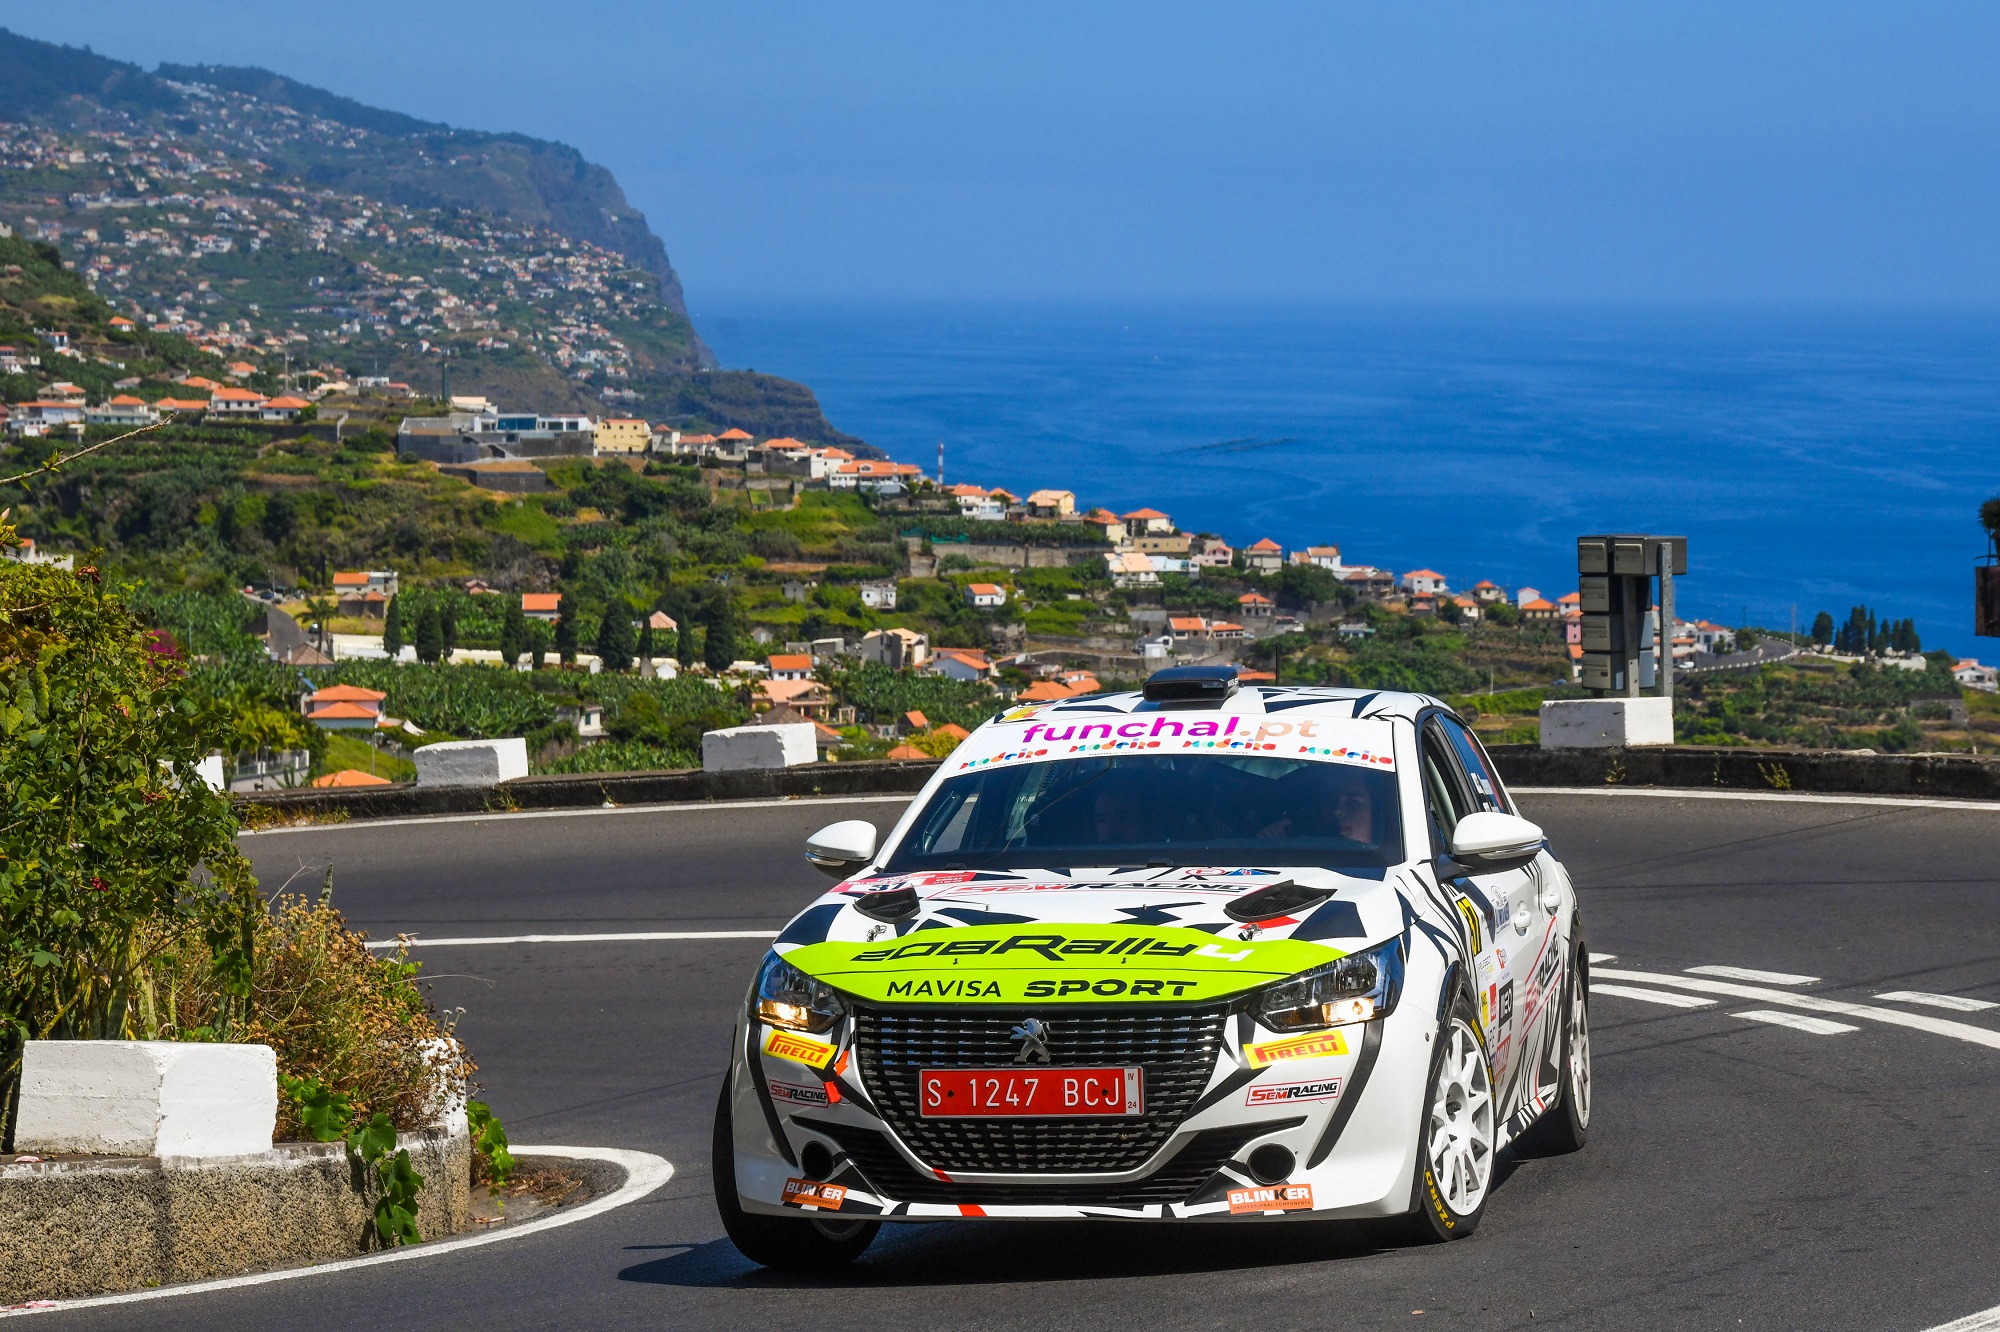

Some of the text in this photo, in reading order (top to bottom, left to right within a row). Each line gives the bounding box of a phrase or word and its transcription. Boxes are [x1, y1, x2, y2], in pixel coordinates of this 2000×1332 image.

[1022, 717, 1319, 743] funchal.pt
[887, 978, 1198, 997] MAVISA SPORT
[768, 1034, 830, 1064] PIRELLI
[1254, 1034, 1339, 1064] PIRELLI
[927, 1077, 1120, 1107] S 1247 BCJ
[1127, 1101, 1138, 1109] 24
[785, 1181, 843, 1201] BLINKER
[1231, 1187, 1310, 1205] BLINKER
